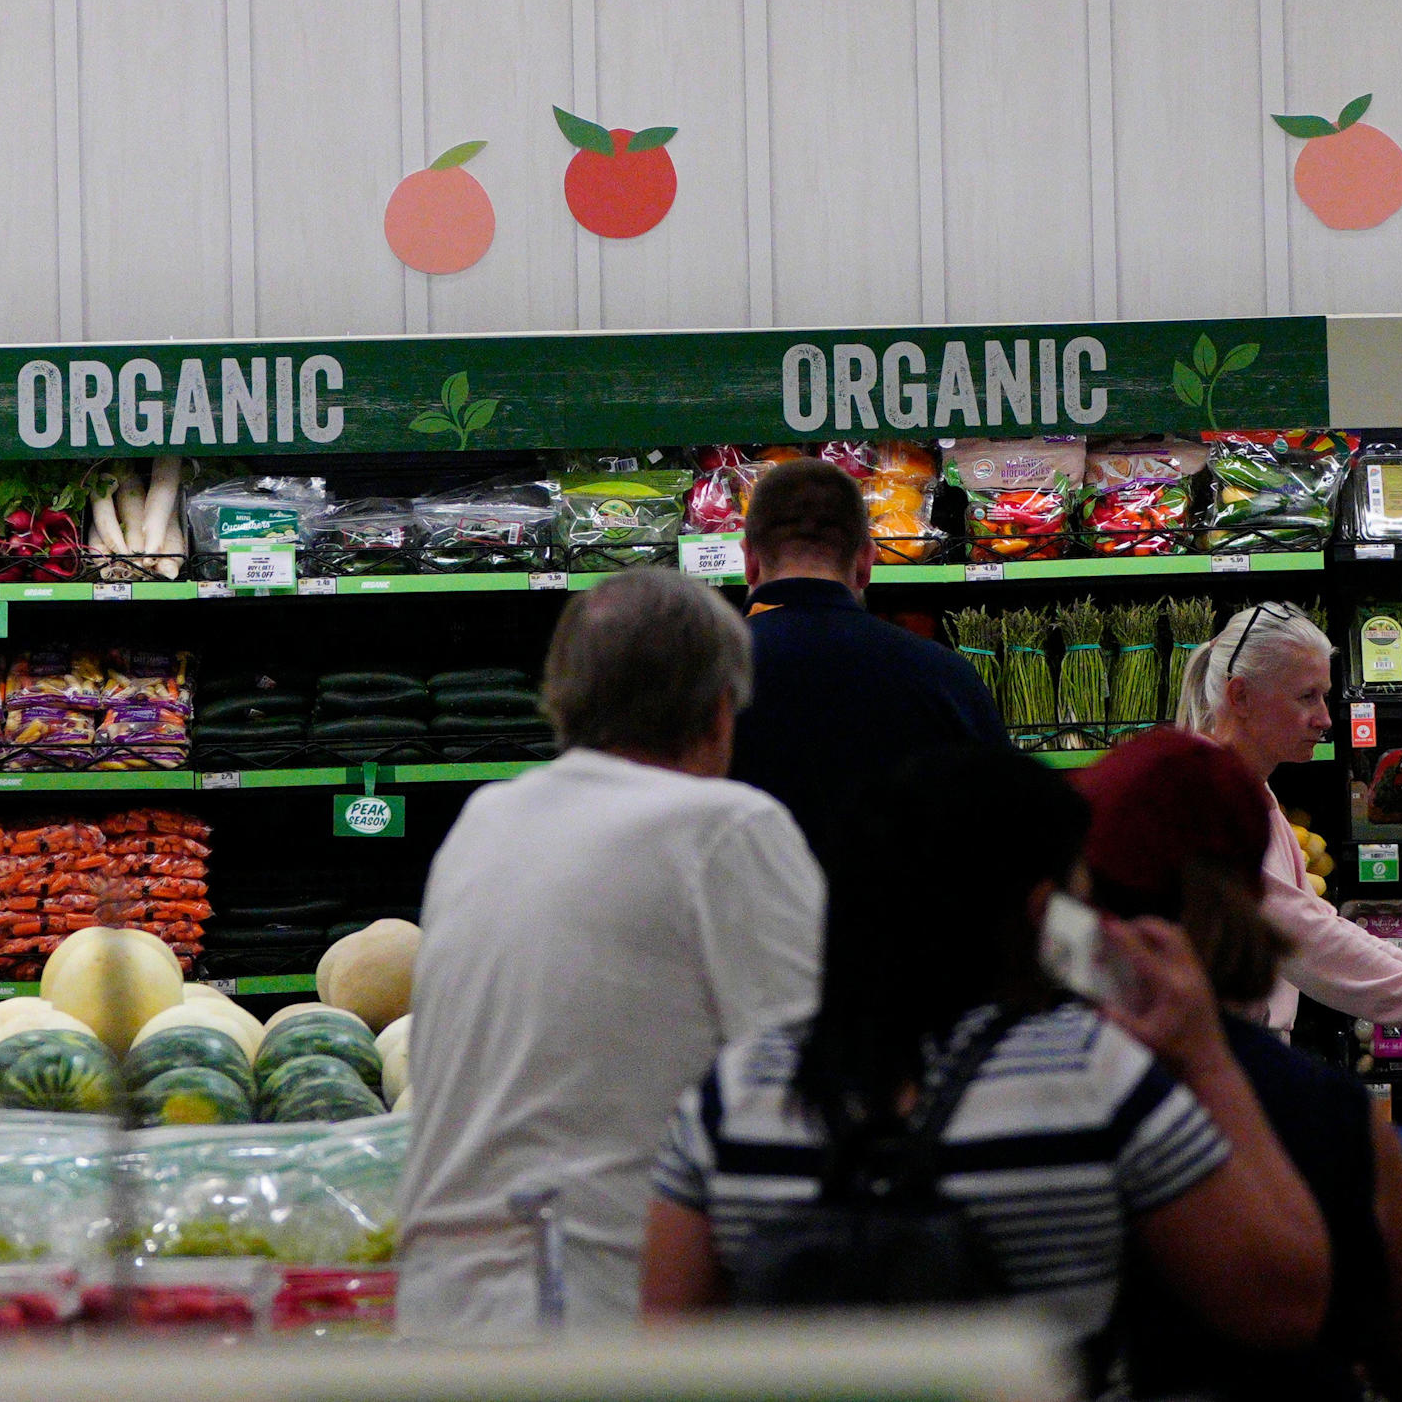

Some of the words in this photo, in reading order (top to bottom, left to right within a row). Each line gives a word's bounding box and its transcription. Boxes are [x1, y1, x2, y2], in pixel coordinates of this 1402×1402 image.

[783, 336, 1108, 432] ORGANIC
[17, 353, 345, 449] ORGANIC
[261, 571, 275, 579] OFF
[351, 803, 388, 816] PEAK
[348, 815, 388, 827] SEASON
